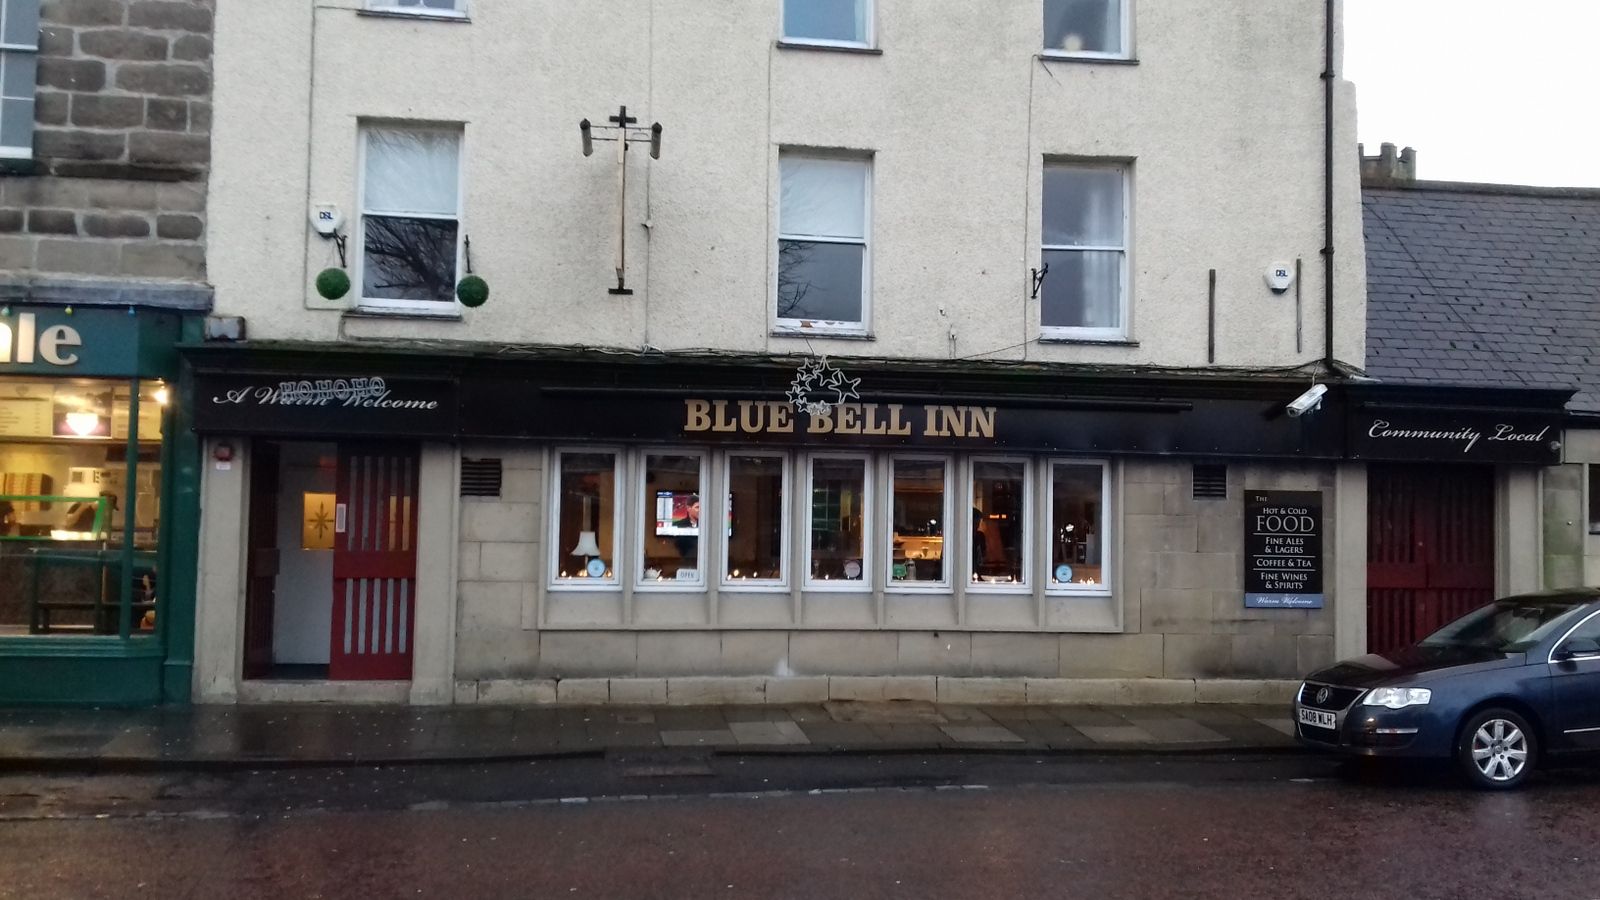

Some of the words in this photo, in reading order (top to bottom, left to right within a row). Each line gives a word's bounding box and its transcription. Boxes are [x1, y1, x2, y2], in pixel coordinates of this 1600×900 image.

[213, 385, 254, 404] A
[341, 389, 439, 410] Welcome
[684, 399, 794, 433] BLUE
[806, 402, 912, 436] BELL
[923, 404, 997, 438] INN
[1368, 419, 1481, 453] Community
[1487, 423, 1551, 442] Local
[1287, 507, 1308, 515] COLD
[1256, 515, 1315, 532] FOOD
[1265, 536, 1284, 545] FINE
[1285, 537, 1304, 545] ALES
[1264, 545, 1272, 553] &
[1275, 546, 1304, 554] LAGERS
[1256, 558, 1286, 567] COFFEE
[1287, 559, 1295, 567] &
[1297, 559, 1312, 567] TEA
[1260, 572, 1279, 580] FINE
[1281, 572, 1308, 581] WINES
[1265, 580, 1273, 589] &
[1274, 581, 1303, 589] SPIRITS
